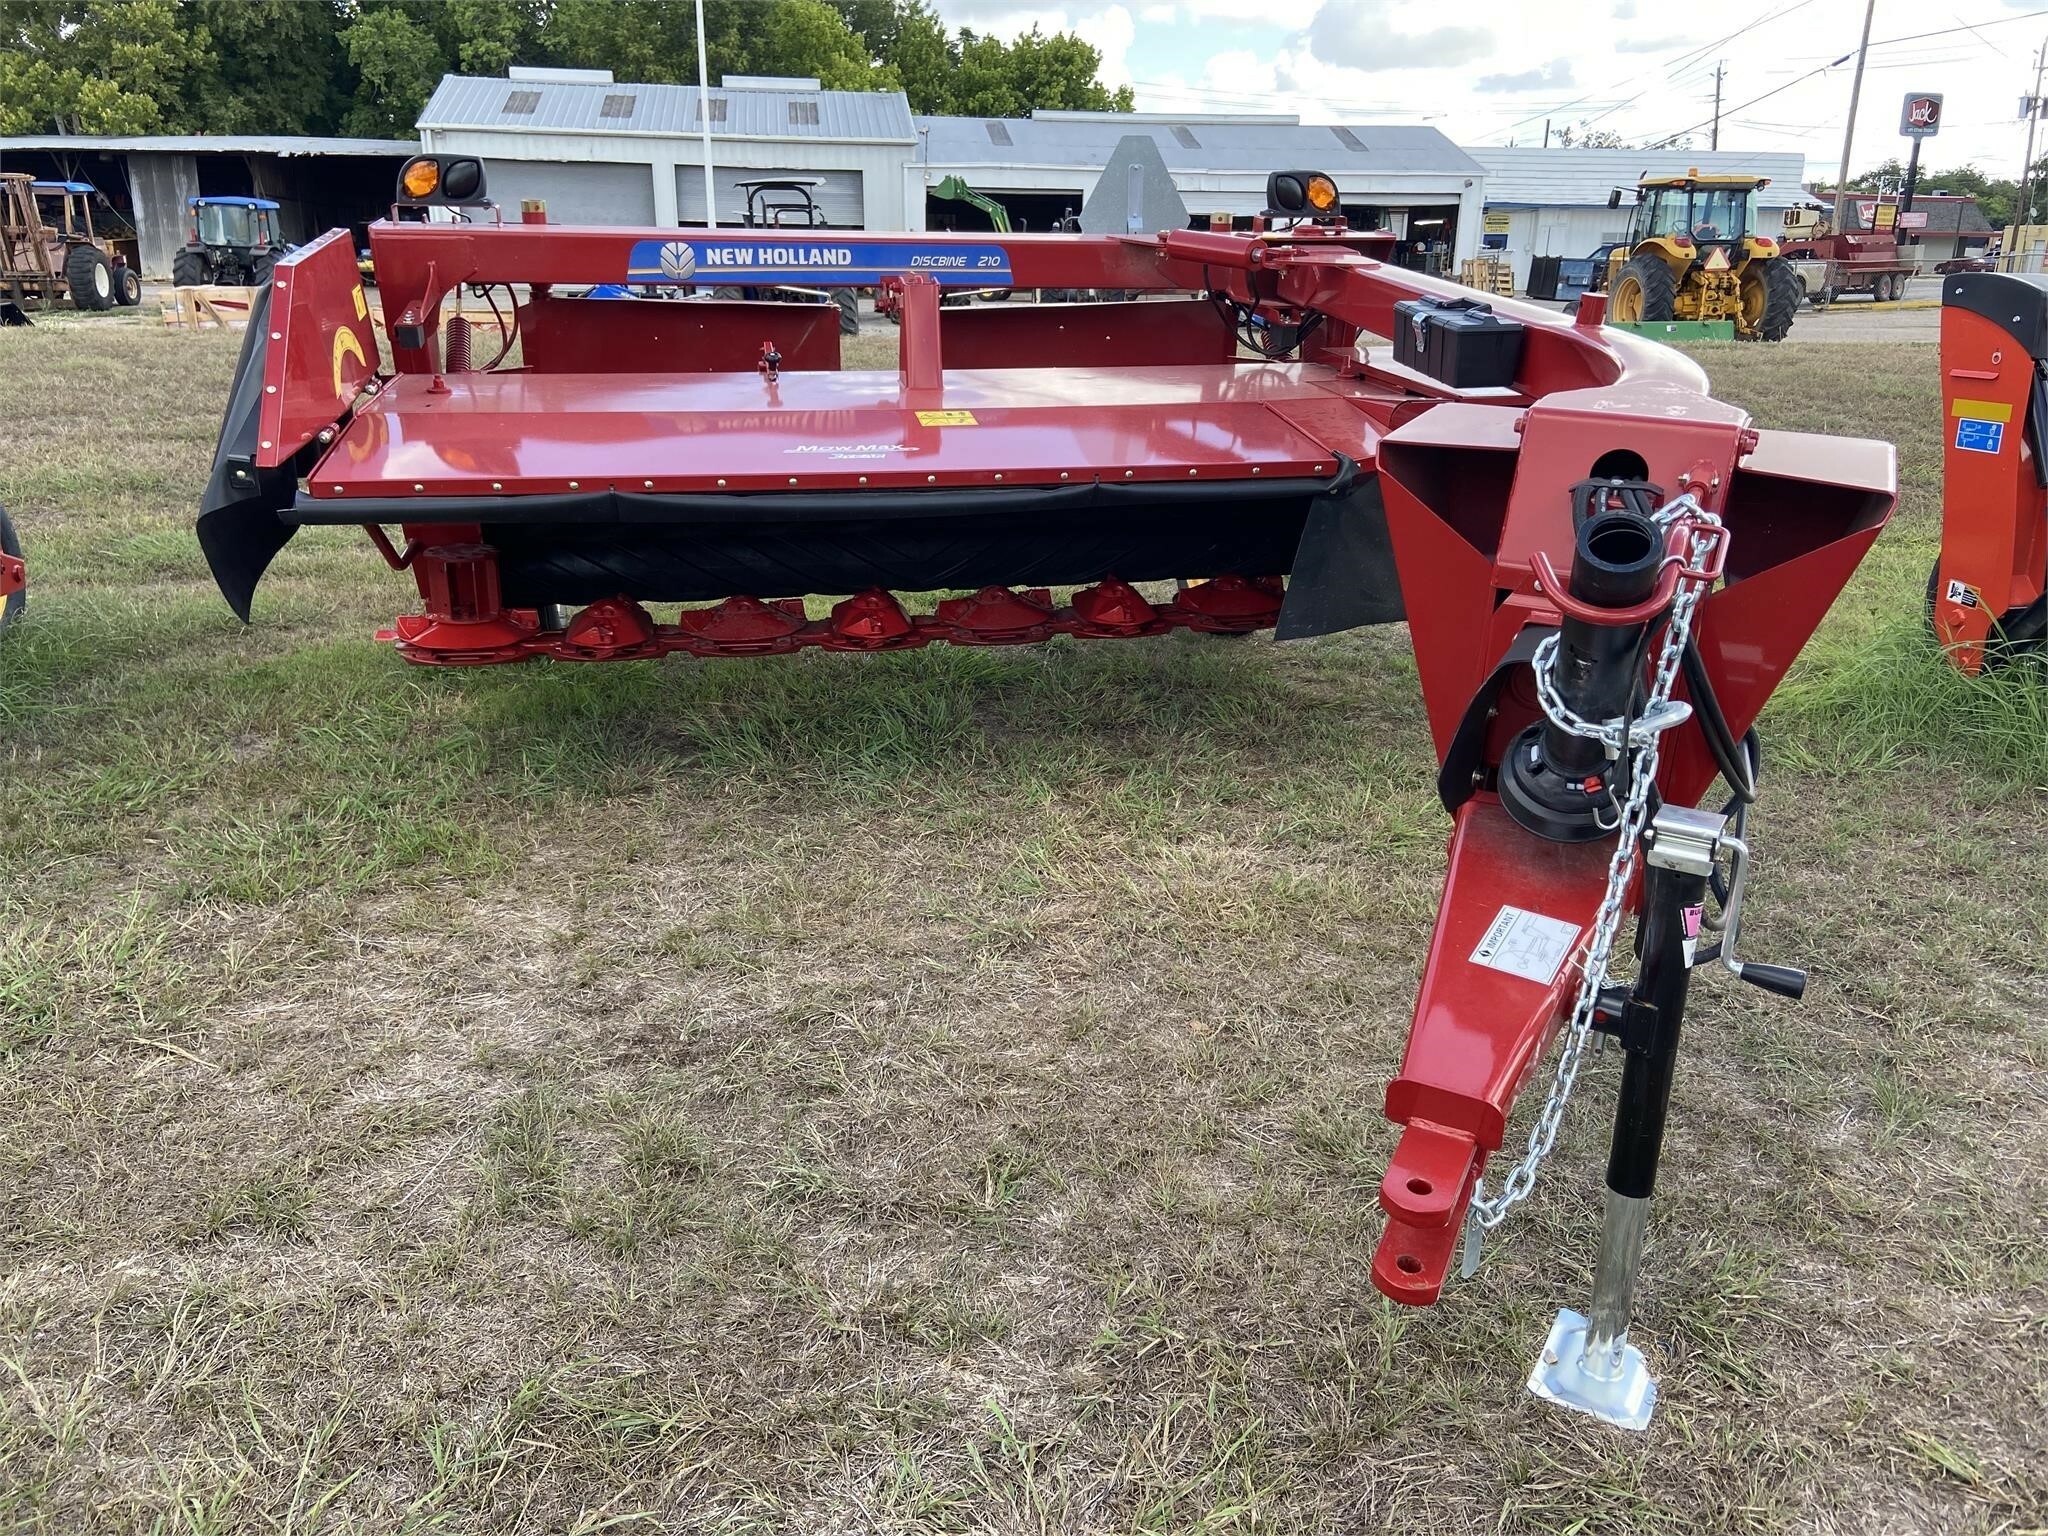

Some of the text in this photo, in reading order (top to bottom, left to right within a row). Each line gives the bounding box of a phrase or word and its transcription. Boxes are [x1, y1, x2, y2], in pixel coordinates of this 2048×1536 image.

[1908, 101, 1938, 123] Jack
[706, 248, 852, 265] NEW HOLLAND
[911, 255, 1001, 267] DISCBINE 210
[1487, 912, 1515, 950] IMPORTANT
